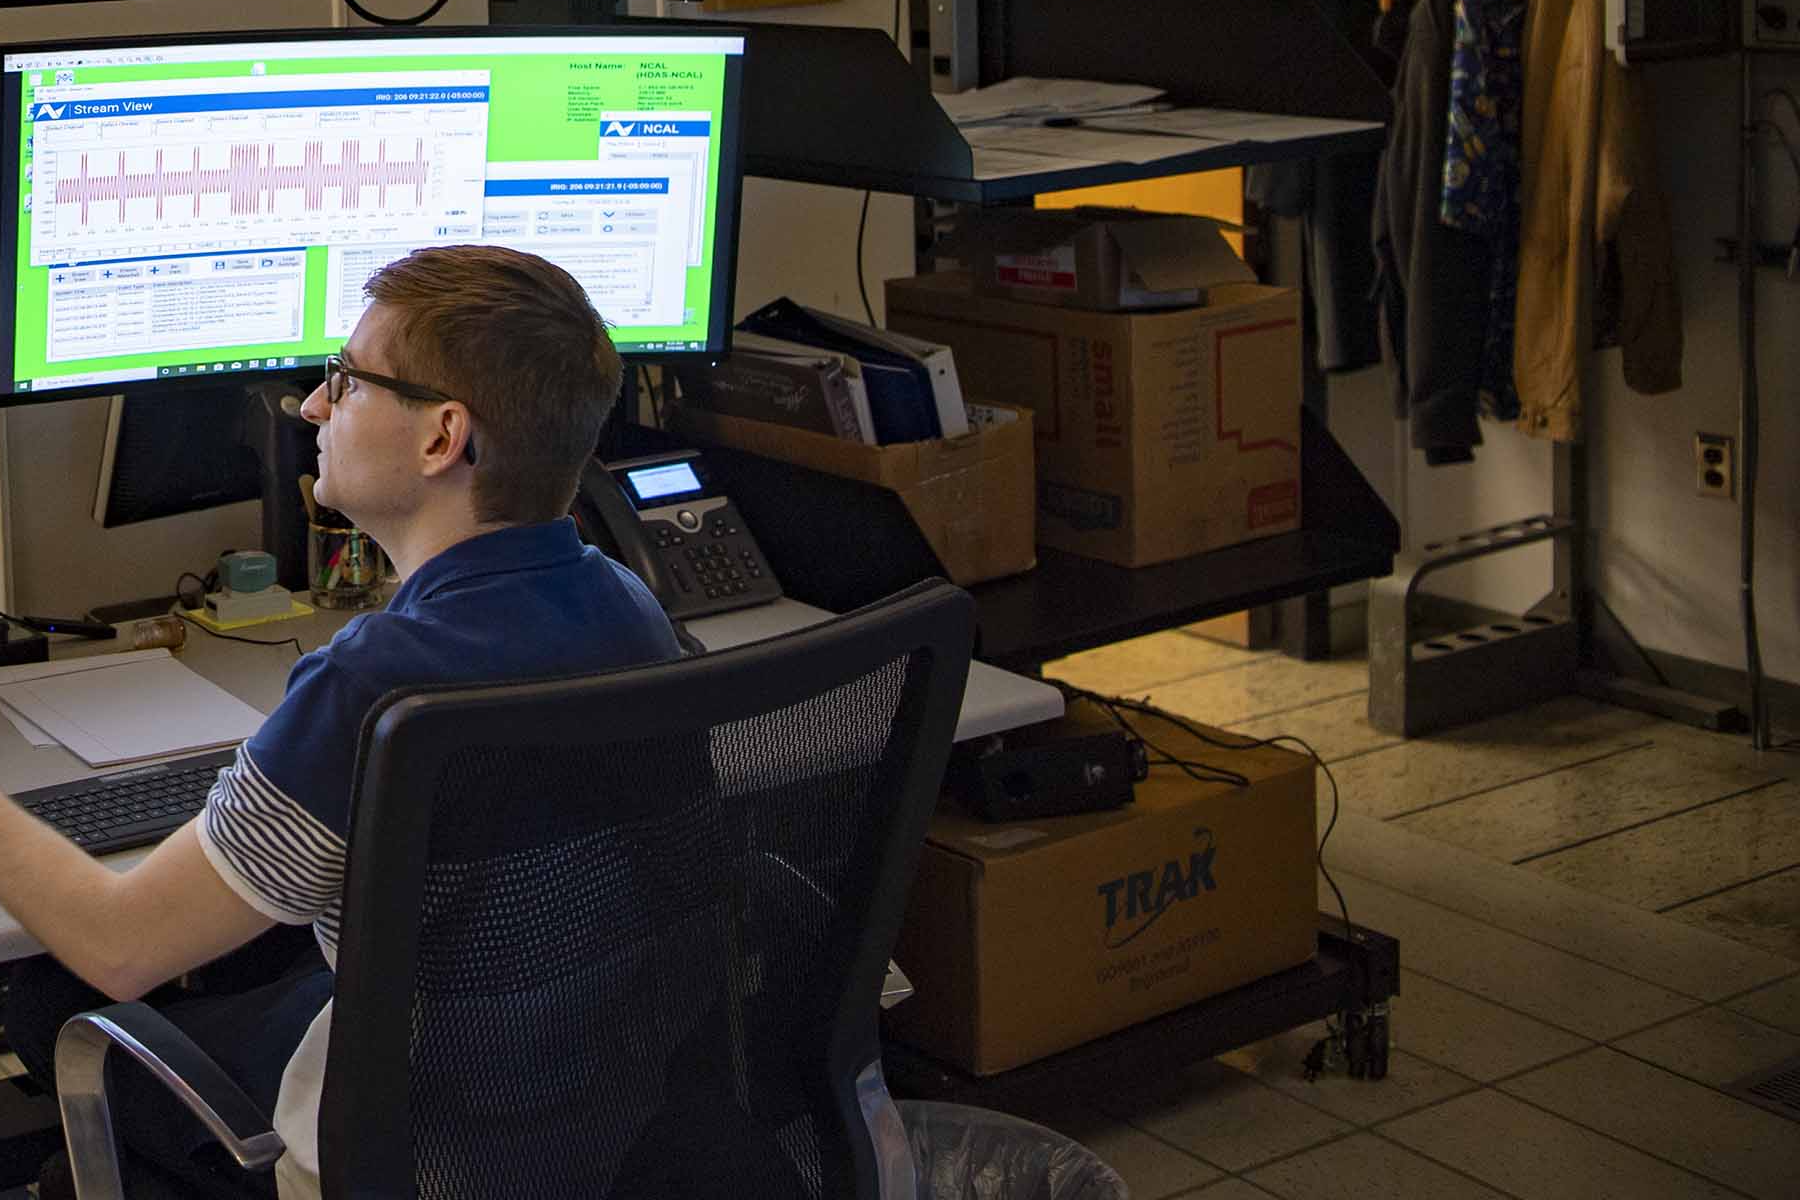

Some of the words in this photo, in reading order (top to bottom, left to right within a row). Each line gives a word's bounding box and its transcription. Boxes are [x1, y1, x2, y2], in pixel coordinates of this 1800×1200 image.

[636, 71, 703, 79] (HDAS-NCAL)
[74, 103, 119, 116] Stream
[123, 101, 153, 112] View
[643, 124, 679, 134] NCAL
[1097, 848, 1217, 928] TRAK
